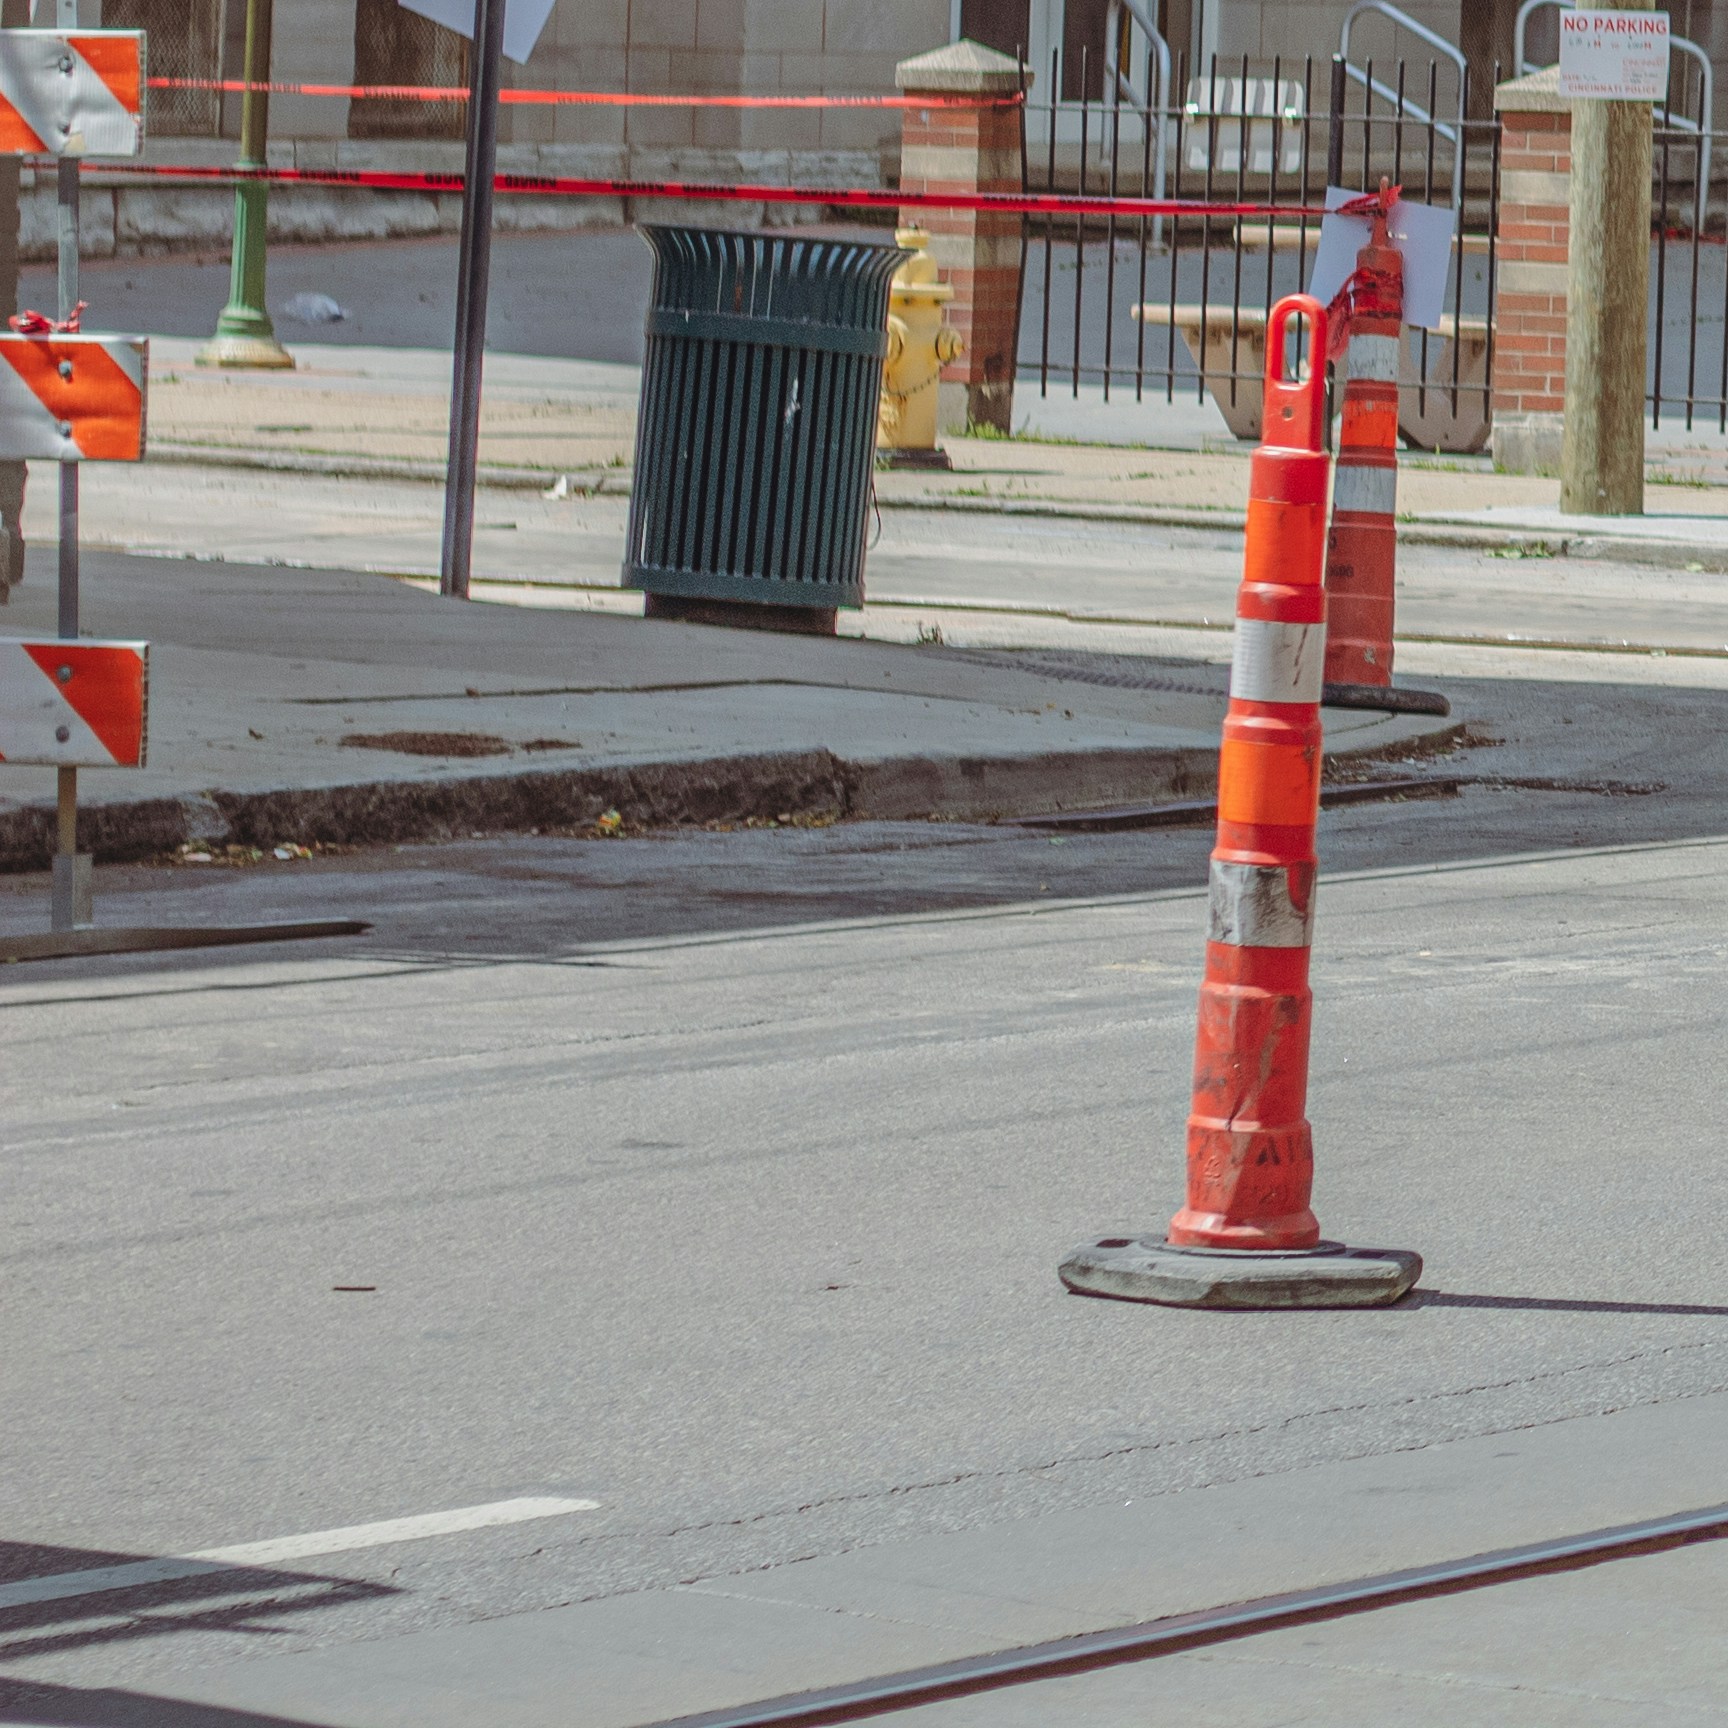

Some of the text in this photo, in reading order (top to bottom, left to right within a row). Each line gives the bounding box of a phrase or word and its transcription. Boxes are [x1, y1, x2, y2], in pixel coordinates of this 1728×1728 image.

[1564, 17, 1667, 35] NO PARKING
[1568, 83, 1658, 94] CINCINNATI POLICE
